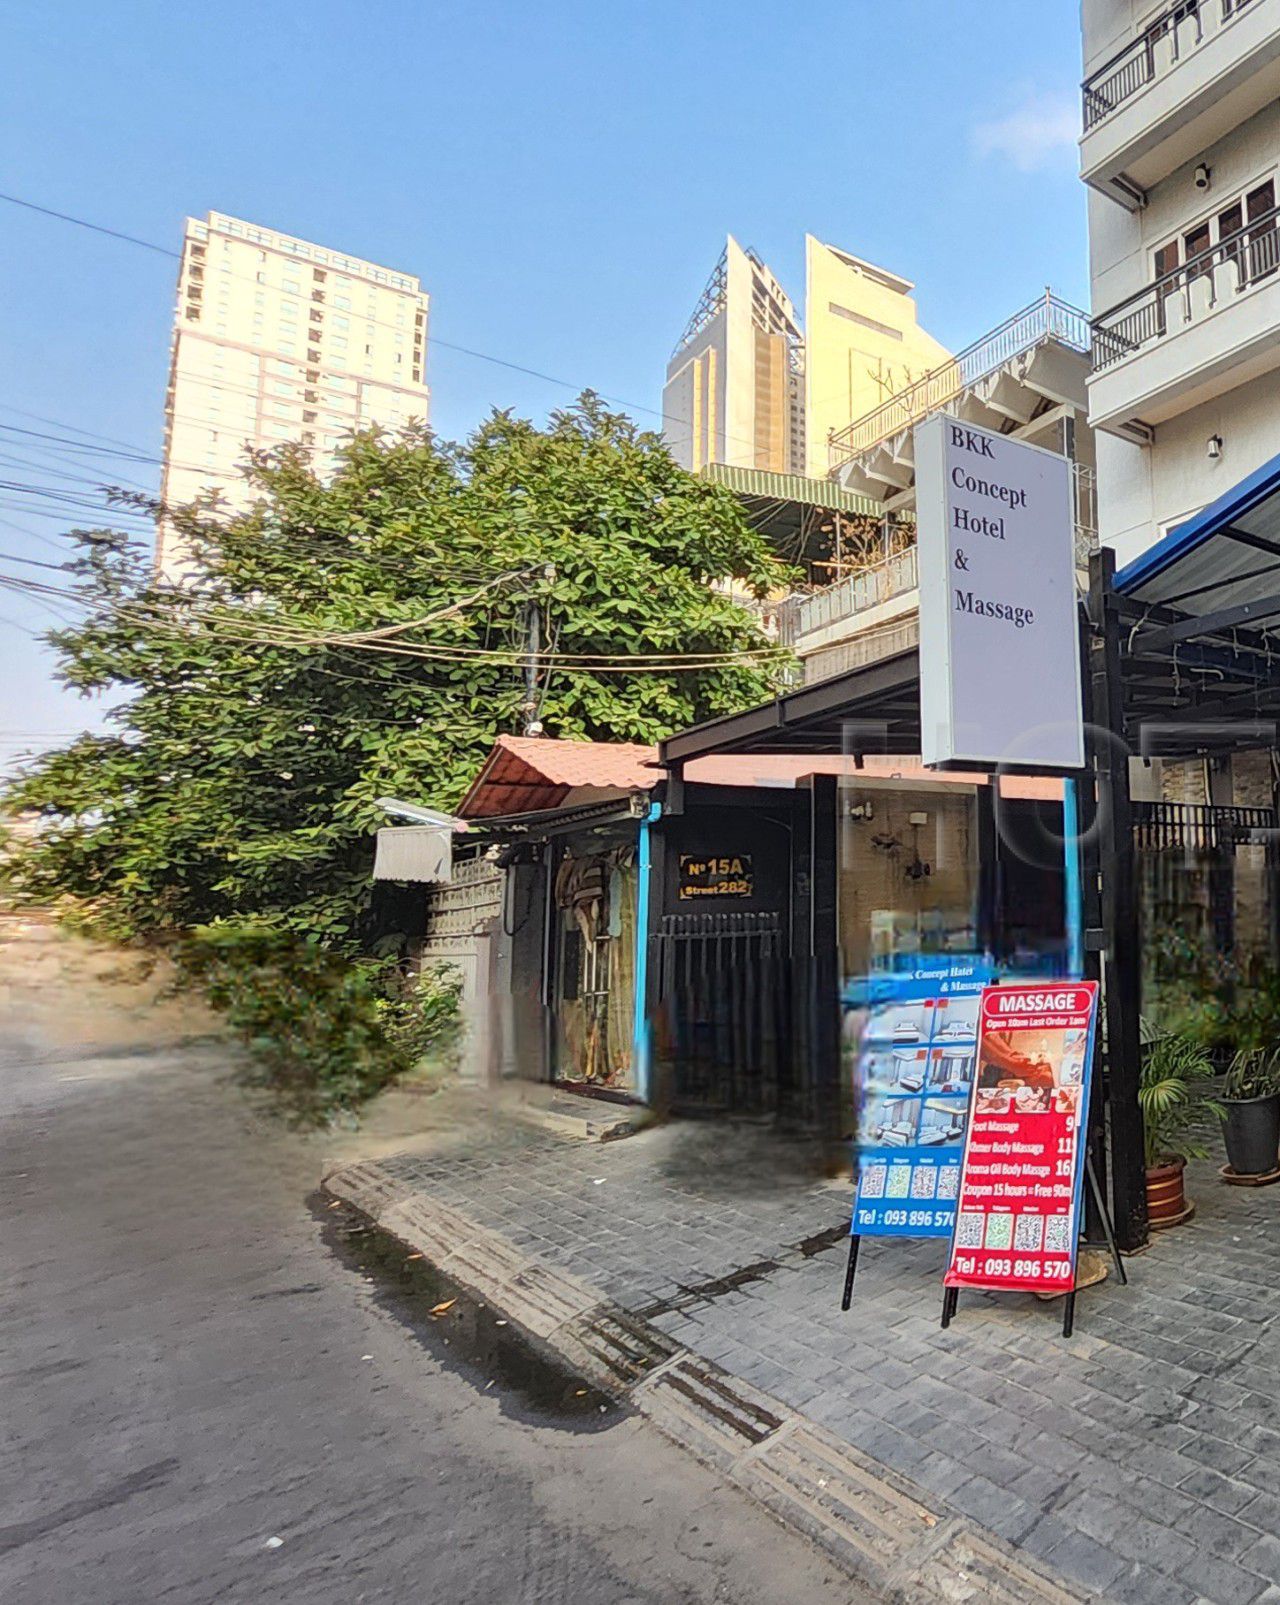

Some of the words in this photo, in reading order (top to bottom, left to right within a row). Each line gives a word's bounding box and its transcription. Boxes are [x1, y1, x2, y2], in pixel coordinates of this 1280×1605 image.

[950, 424, 995, 460] BKK
[951, 467, 1027, 509] Concept
[953, 507, 1006, 540] Hotel
[955, 549, 970, 572] &
[955, 590, 1034, 628] Massage
[707, 858, 743, 875] 15A
[684, 885, 719, 895] Street
[719, 881, 748, 894] 282
[940, 982, 949, 992] &
[999, 993, 1076, 1012] MASSAGE
[1029, 1018, 1045, 1027] Last
[1045, 1017, 1069, 1026] Order
[993, 1183, 1004, 1196] 15
[1004, 1183, 1027, 1196] hours
[858, 1209, 876, 1225] Tel
[884, 1210, 907, 1226] 093
[909, 1210, 933, 1226] 896
[956, 1257, 976, 1274] Tel
[985, 1258, 1012, 1276] 093
[1013, 1259, 1041, 1278] 896
[1043, 1260, 1071, 1279] 570
